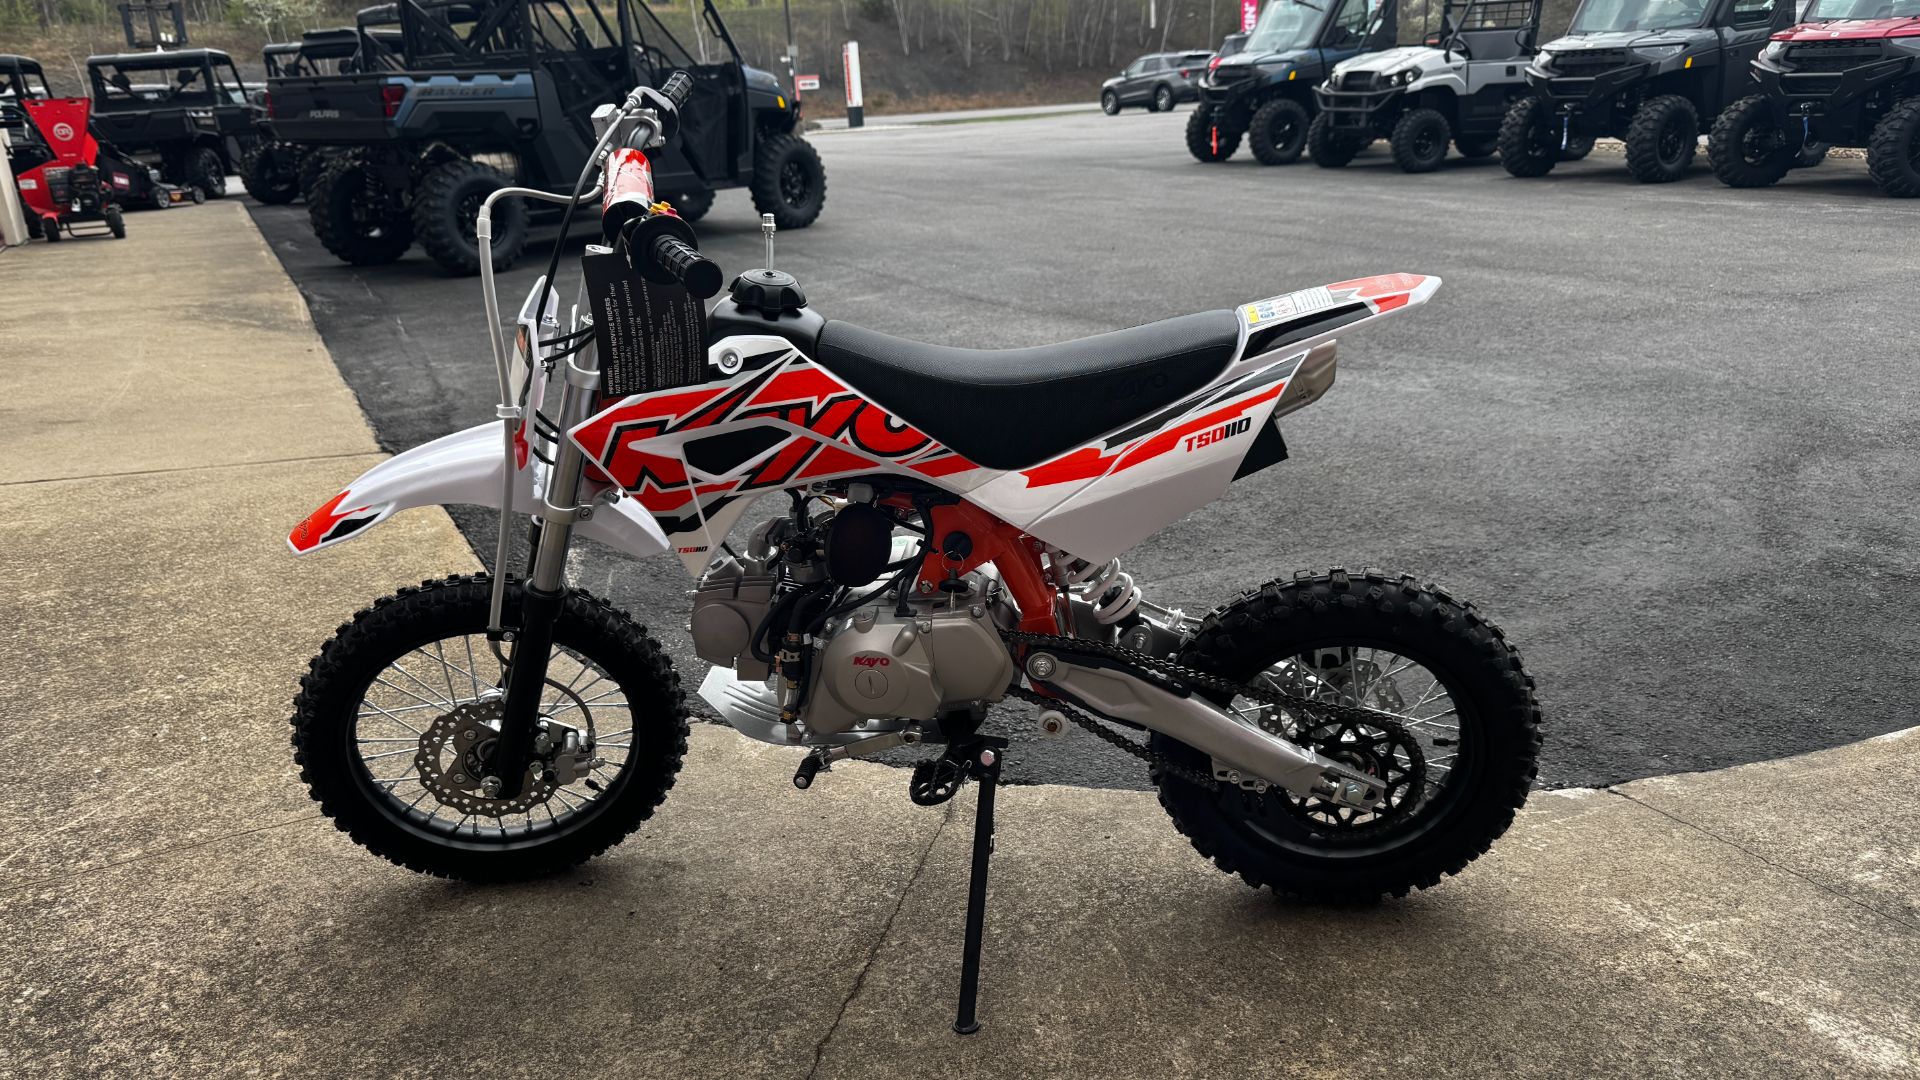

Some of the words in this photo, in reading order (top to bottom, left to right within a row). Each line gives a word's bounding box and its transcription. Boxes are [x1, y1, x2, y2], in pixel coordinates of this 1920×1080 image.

[424, 86, 497, 97] RANGER
[310, 110, 340, 119] POLARIS
[853, 655, 890, 668] KAYO
